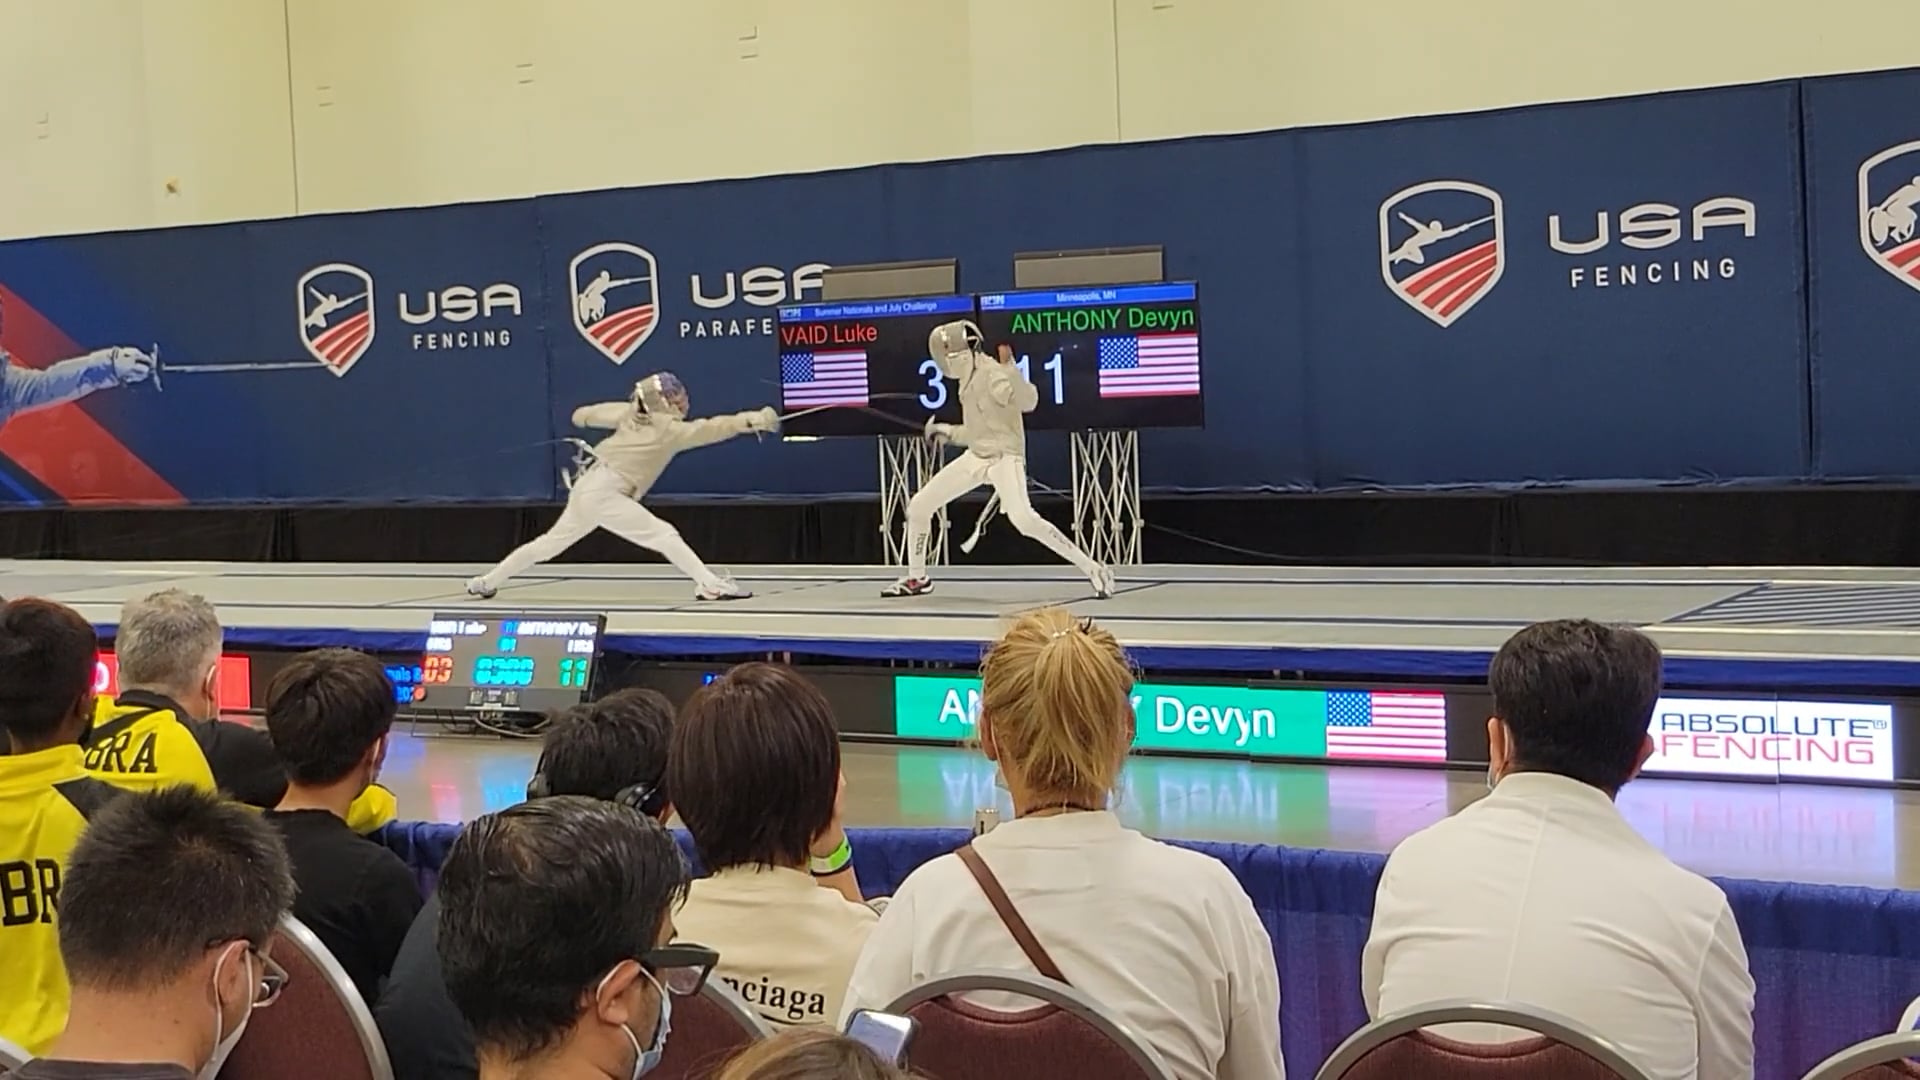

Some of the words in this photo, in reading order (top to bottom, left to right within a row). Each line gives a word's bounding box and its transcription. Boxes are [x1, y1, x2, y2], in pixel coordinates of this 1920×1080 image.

[1548, 197, 1756, 254] USA
[1570, 258, 1736, 289] FENCING
[399, 284, 522, 324] USA
[781, 325, 828, 345] VAID
[834, 323, 878, 343] Luke
[1011, 310, 1121, 334] ANTHONY
[1129, 307, 1194, 331] Devyn
[412, 330, 511, 351] FENCING
[918, 359, 947, 409] 3
[559, 657, 588, 687] 11
[1155, 696, 1276, 745] Devyn
[1661, 734, 1874, 765] FENCING
